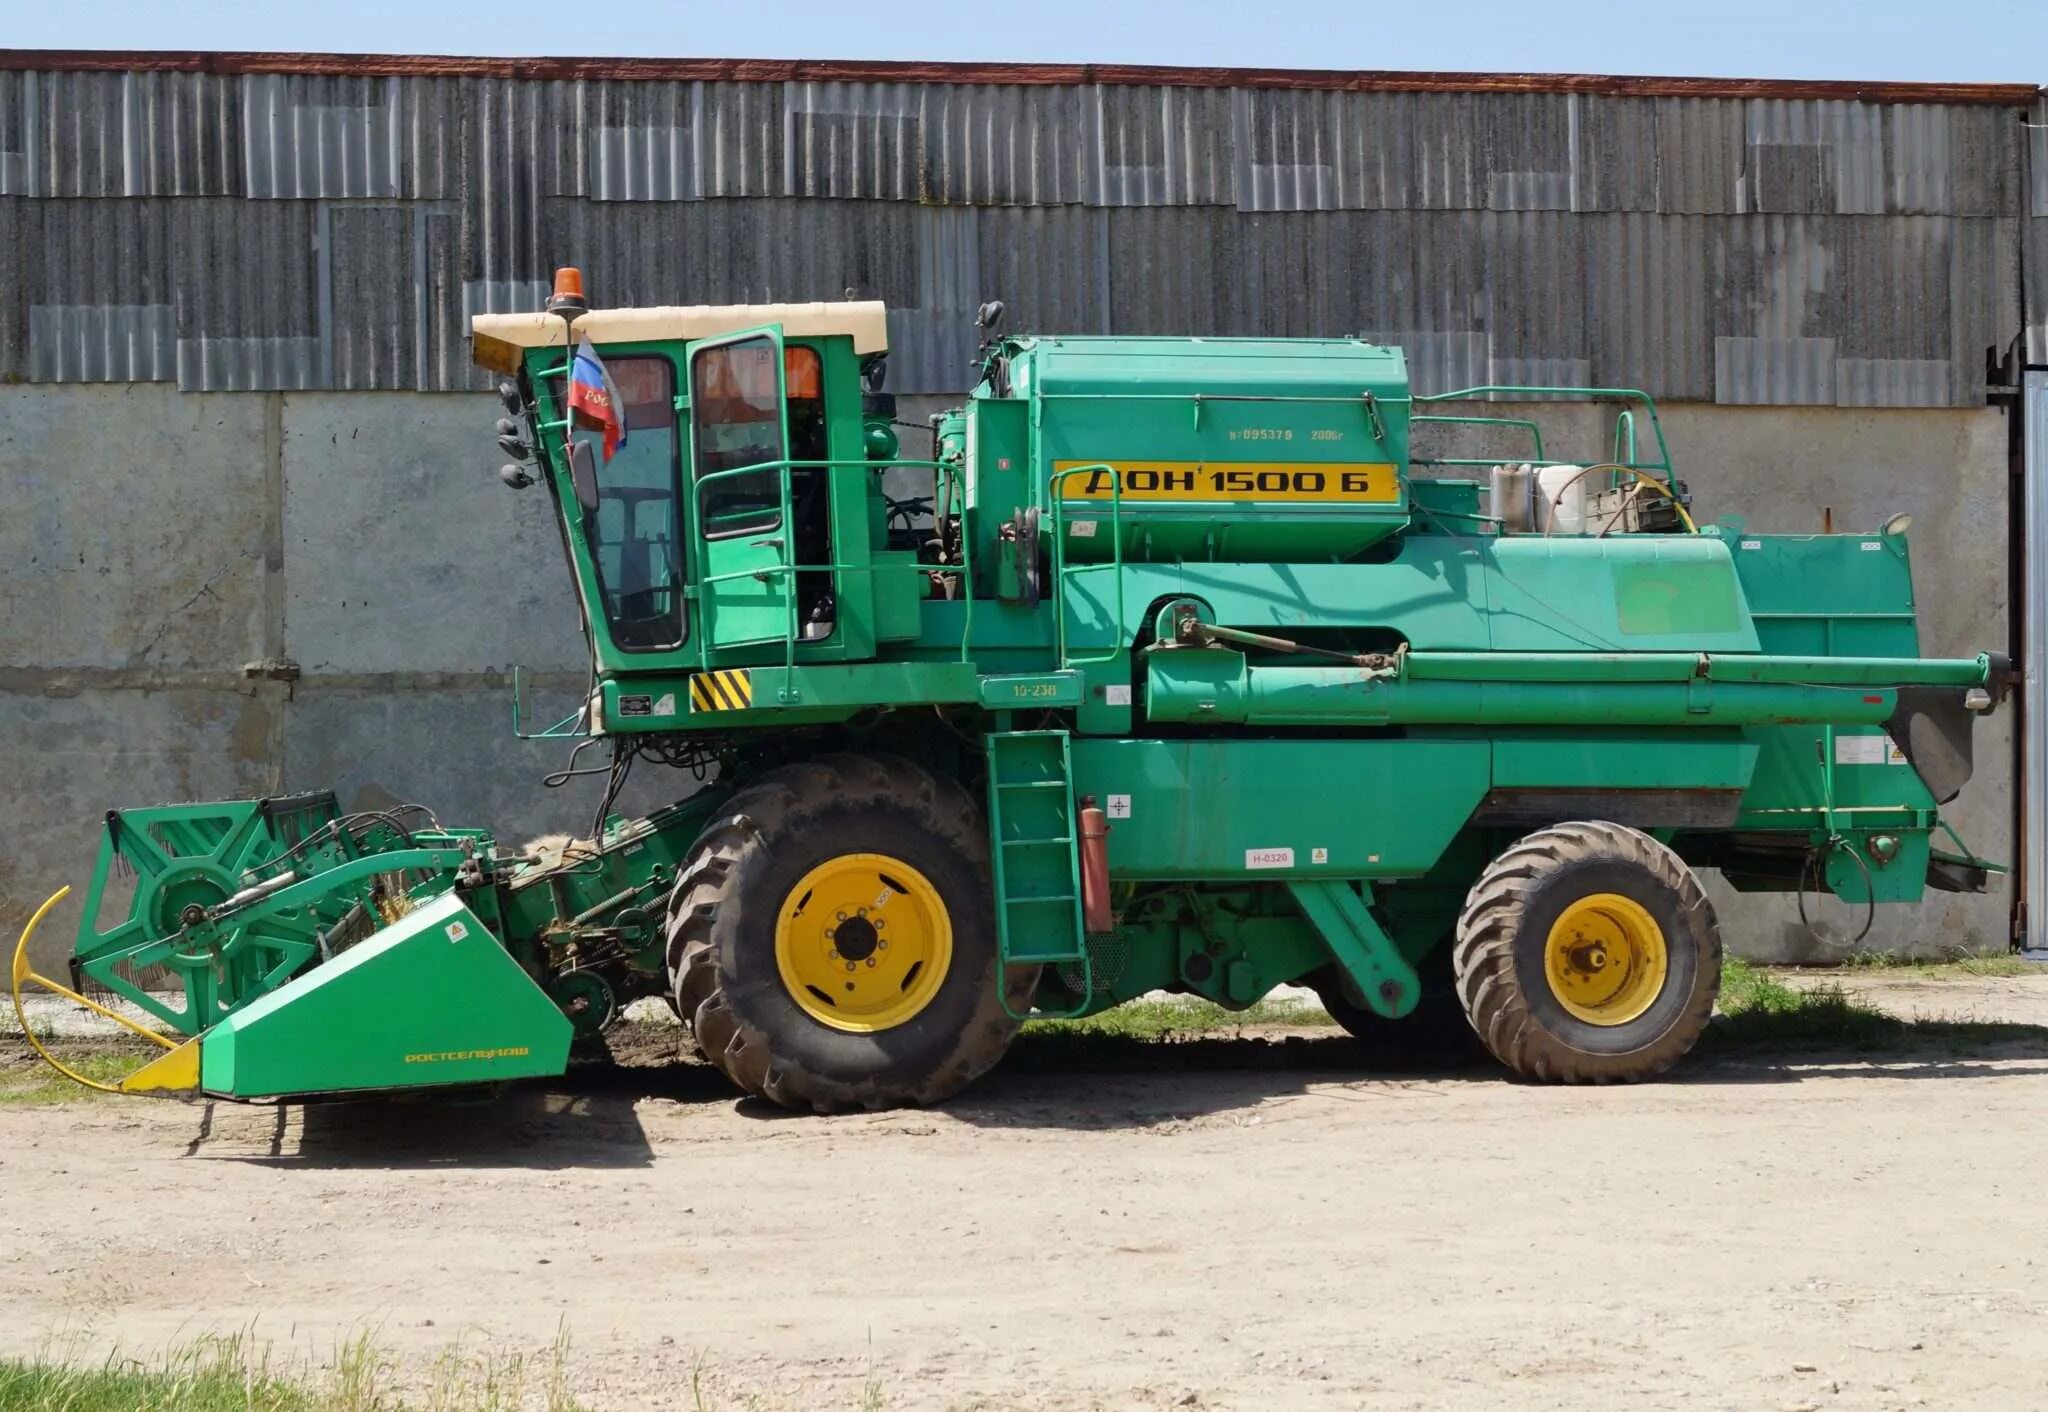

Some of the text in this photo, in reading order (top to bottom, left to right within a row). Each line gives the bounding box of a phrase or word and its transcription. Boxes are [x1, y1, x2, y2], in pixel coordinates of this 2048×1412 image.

[1085, 470, 1195, 494] ДОН
[1210, 472, 1326, 493] 1500
[405, 1047, 529, 1063] РОСТСЕЛЬМАШ
